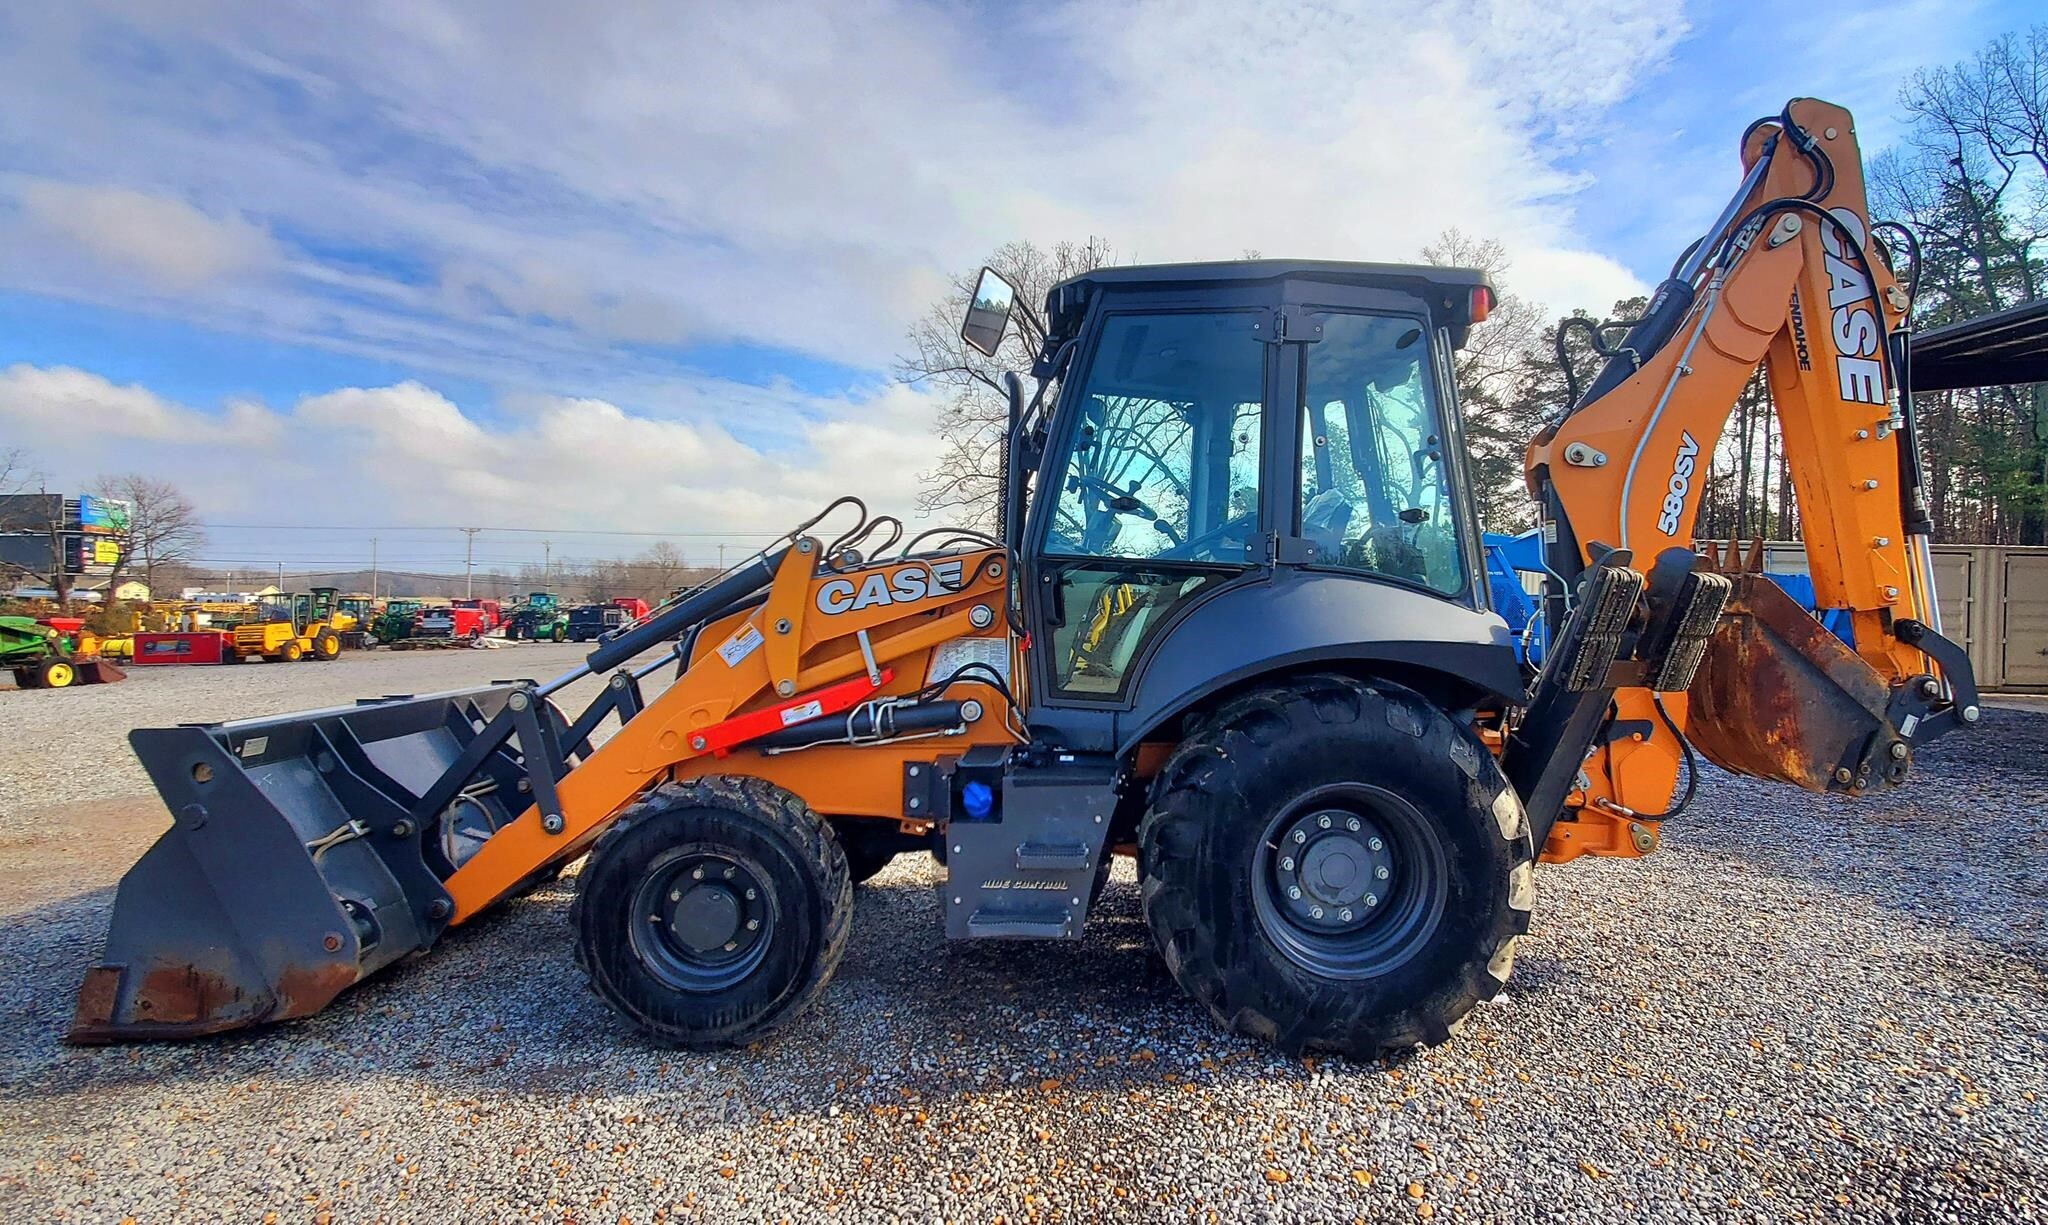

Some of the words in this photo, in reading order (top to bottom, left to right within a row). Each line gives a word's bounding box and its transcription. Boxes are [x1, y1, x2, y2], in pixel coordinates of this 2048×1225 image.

[1819, 207, 1886, 405] CASE
[1656, 429, 1699, 536] 580SV
[816, 560, 963, 615] CASE
